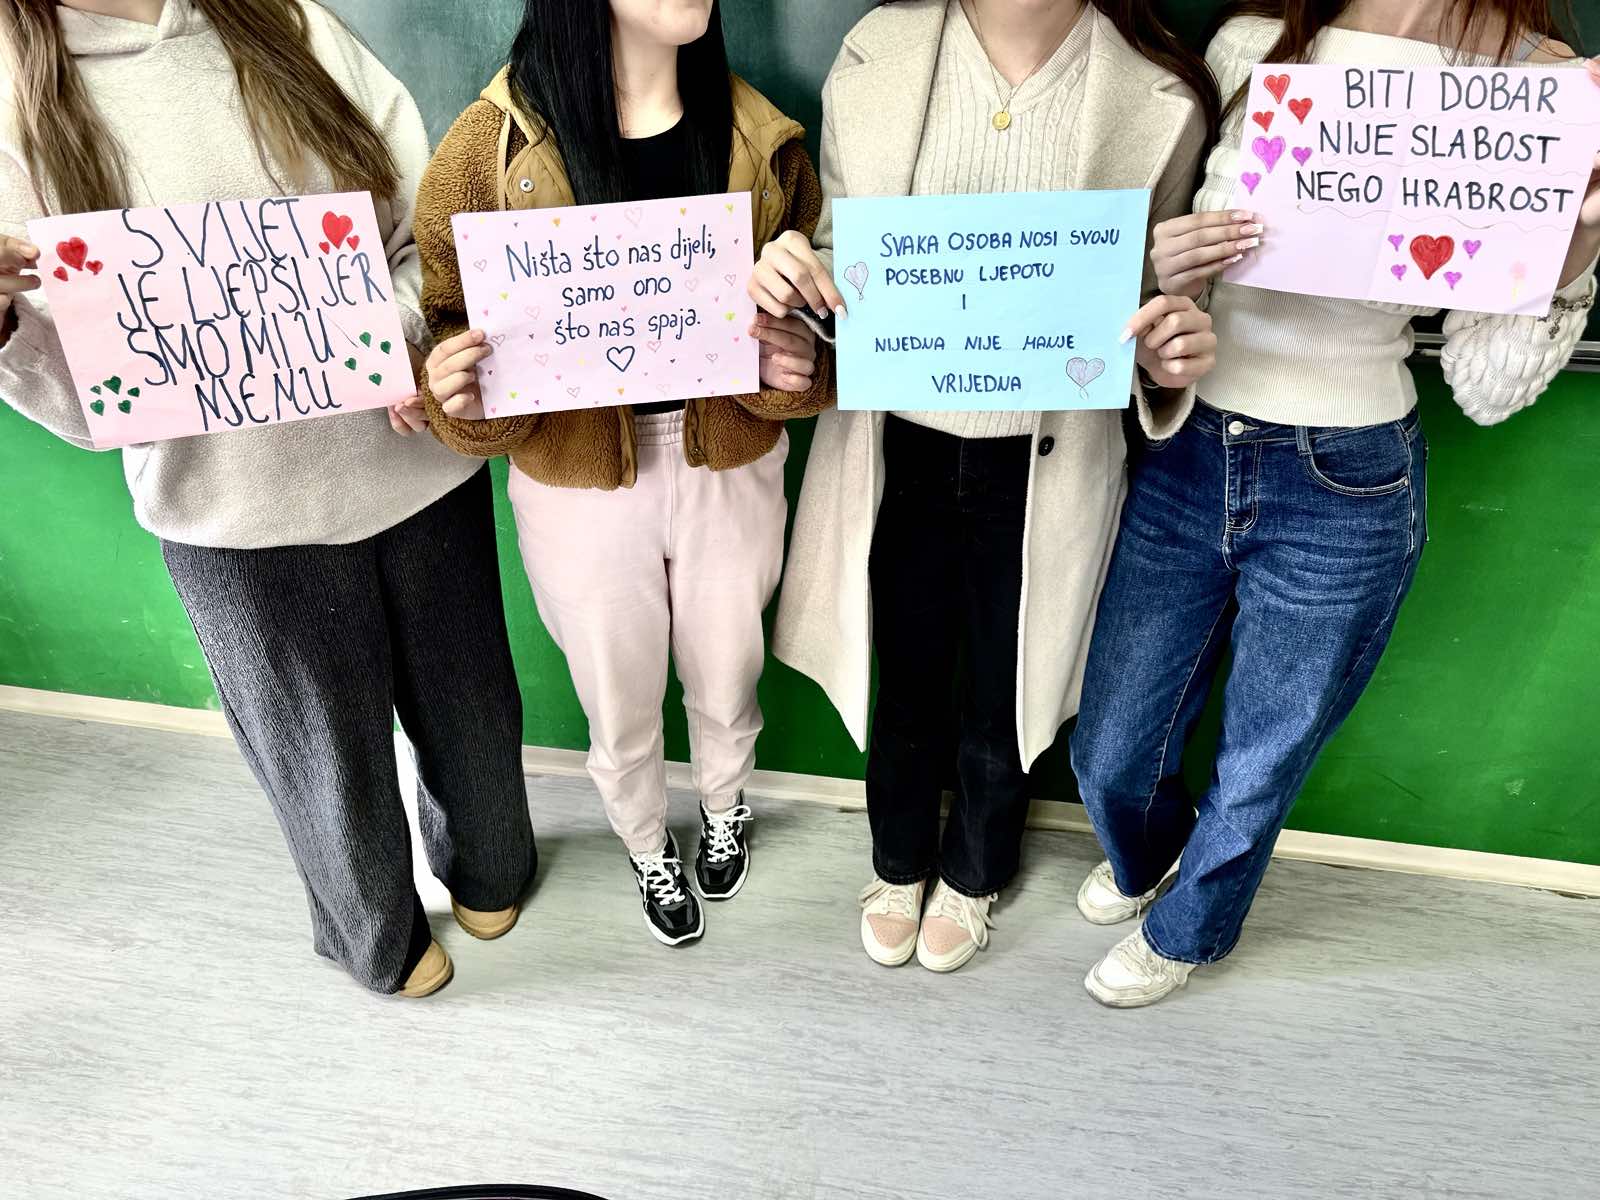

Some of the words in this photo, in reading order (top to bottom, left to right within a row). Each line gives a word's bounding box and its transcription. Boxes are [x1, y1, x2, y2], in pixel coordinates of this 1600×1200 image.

[1344, 68, 1412, 109] BITI
[1440, 71, 1557, 113] DOBAR
[1319, 120, 1396, 155] NIJE
[1410, 124, 1559, 164] SLABOST
[1295, 170, 1382, 203] NEGO
[1401, 177, 1573, 213] HRABROST
[505, 238, 571, 281] Ništa
[582, 234, 619, 270] što
[627, 242, 660, 264] nas
[670, 223, 716, 270] dijeli,
[879, 231, 938, 258] SVAKA
[947, 231, 1011, 251] OSOBA
[1019, 229, 1056, 248] NOSI
[1069, 227, 1119, 246] SVOJU
[117, 271, 173, 331] JE
[182, 256, 310, 324] LJEPŠI
[319, 251, 386, 306] JER
[561, 284, 614, 307] samo
[632, 276, 671, 296] ono
[884, 266, 963, 286] POSEBNU
[978, 262, 1054, 282] LJEPOTU
[961, 294, 967, 310] I
[553, 311, 589, 344] što
[598, 317, 634, 338] nas
[647, 307, 700, 340] spaja.
[874, 335, 944, 352] NIJEDNA
[964, 334, 1001, 350] NIJE
[1022, 334, 1074, 350] MANJE
[126, 322, 229, 385] SMO
[239, 311, 291, 373] MI
[293, 307, 334, 363] U
[194, 366, 341, 431] NJEMU
[930, 372, 1021, 393] VRIJEDNA
